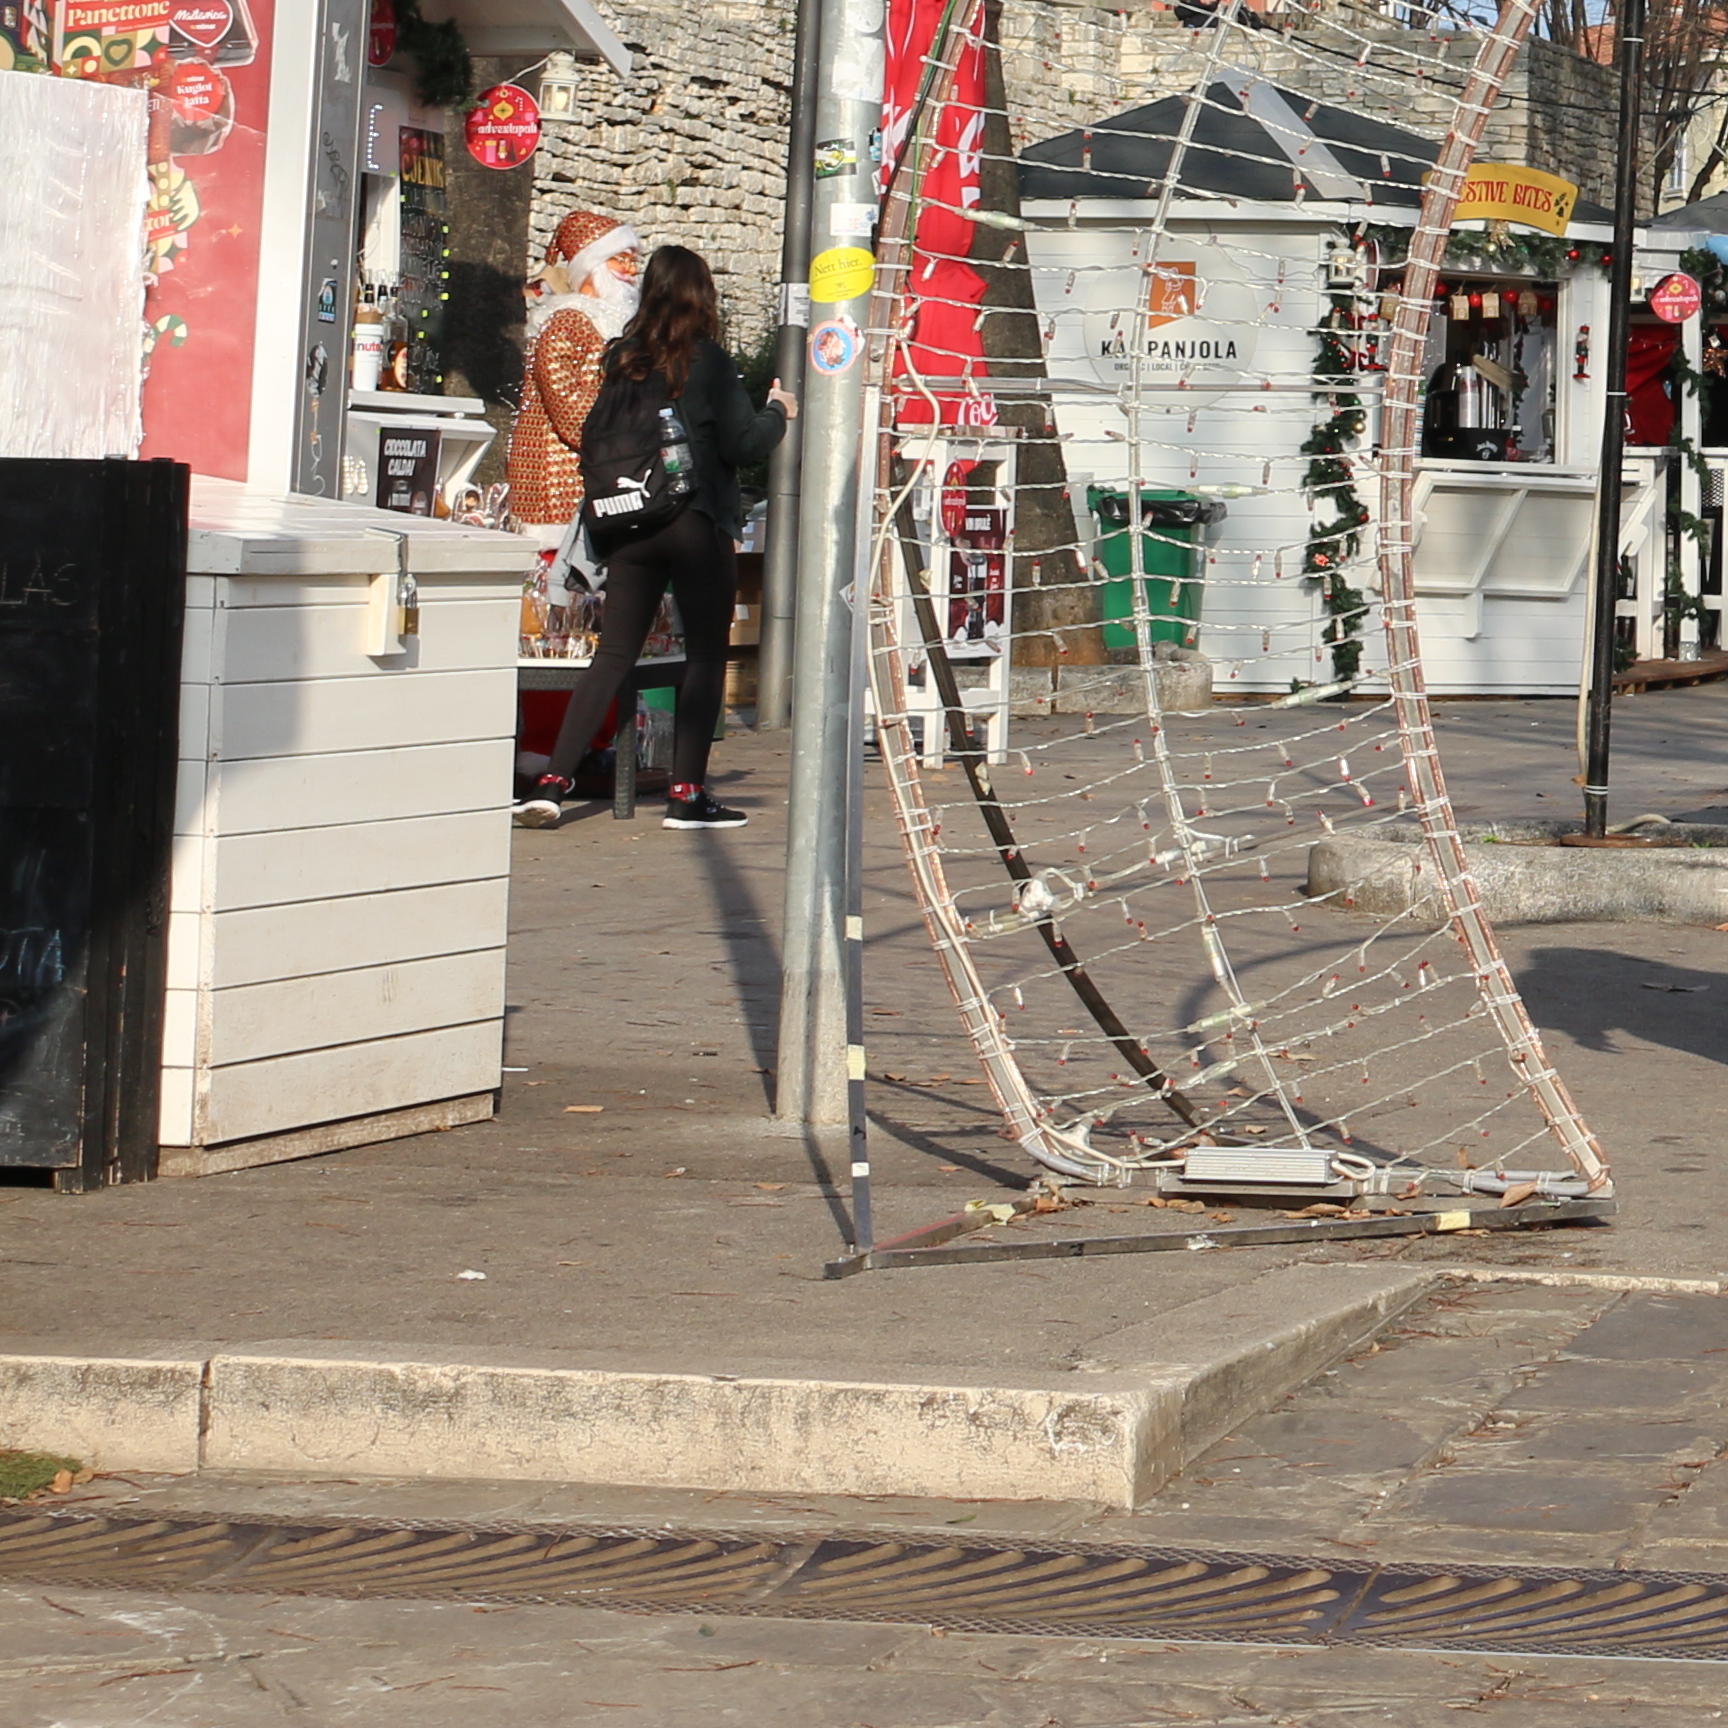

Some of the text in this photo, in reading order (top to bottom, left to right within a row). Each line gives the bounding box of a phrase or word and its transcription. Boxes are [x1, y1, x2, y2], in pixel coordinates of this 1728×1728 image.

[68, 0, 170, 27] Panettone
[1458, 180, 1553, 213] ESTIVE BITES
[1101, 340, 1238, 359] KAPANJOLA
[593, 491, 643, 518] PUMA
